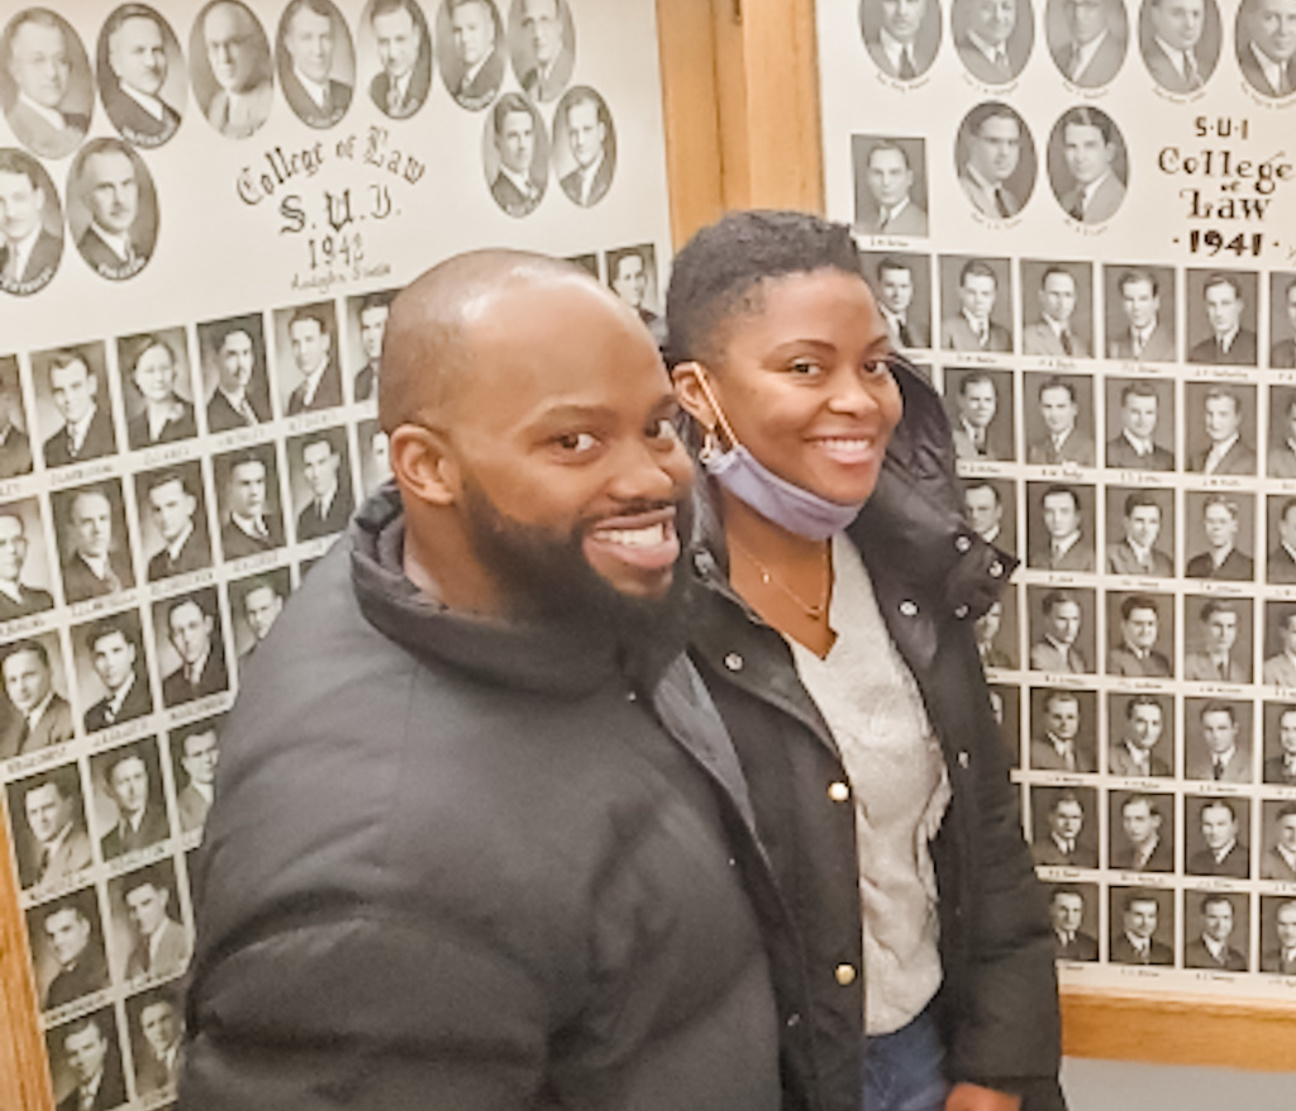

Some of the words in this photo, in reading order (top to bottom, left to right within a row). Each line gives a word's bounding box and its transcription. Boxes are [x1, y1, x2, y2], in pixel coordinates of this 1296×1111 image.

[237, 141, 324, 205] College
[335, 134, 357, 160] of
[364, 125, 425, 185] Law
[1158, 147, 1296, 195] College
[1179, 188, 1271, 221] Law
[1189, 229, 1265, 257] 1941
